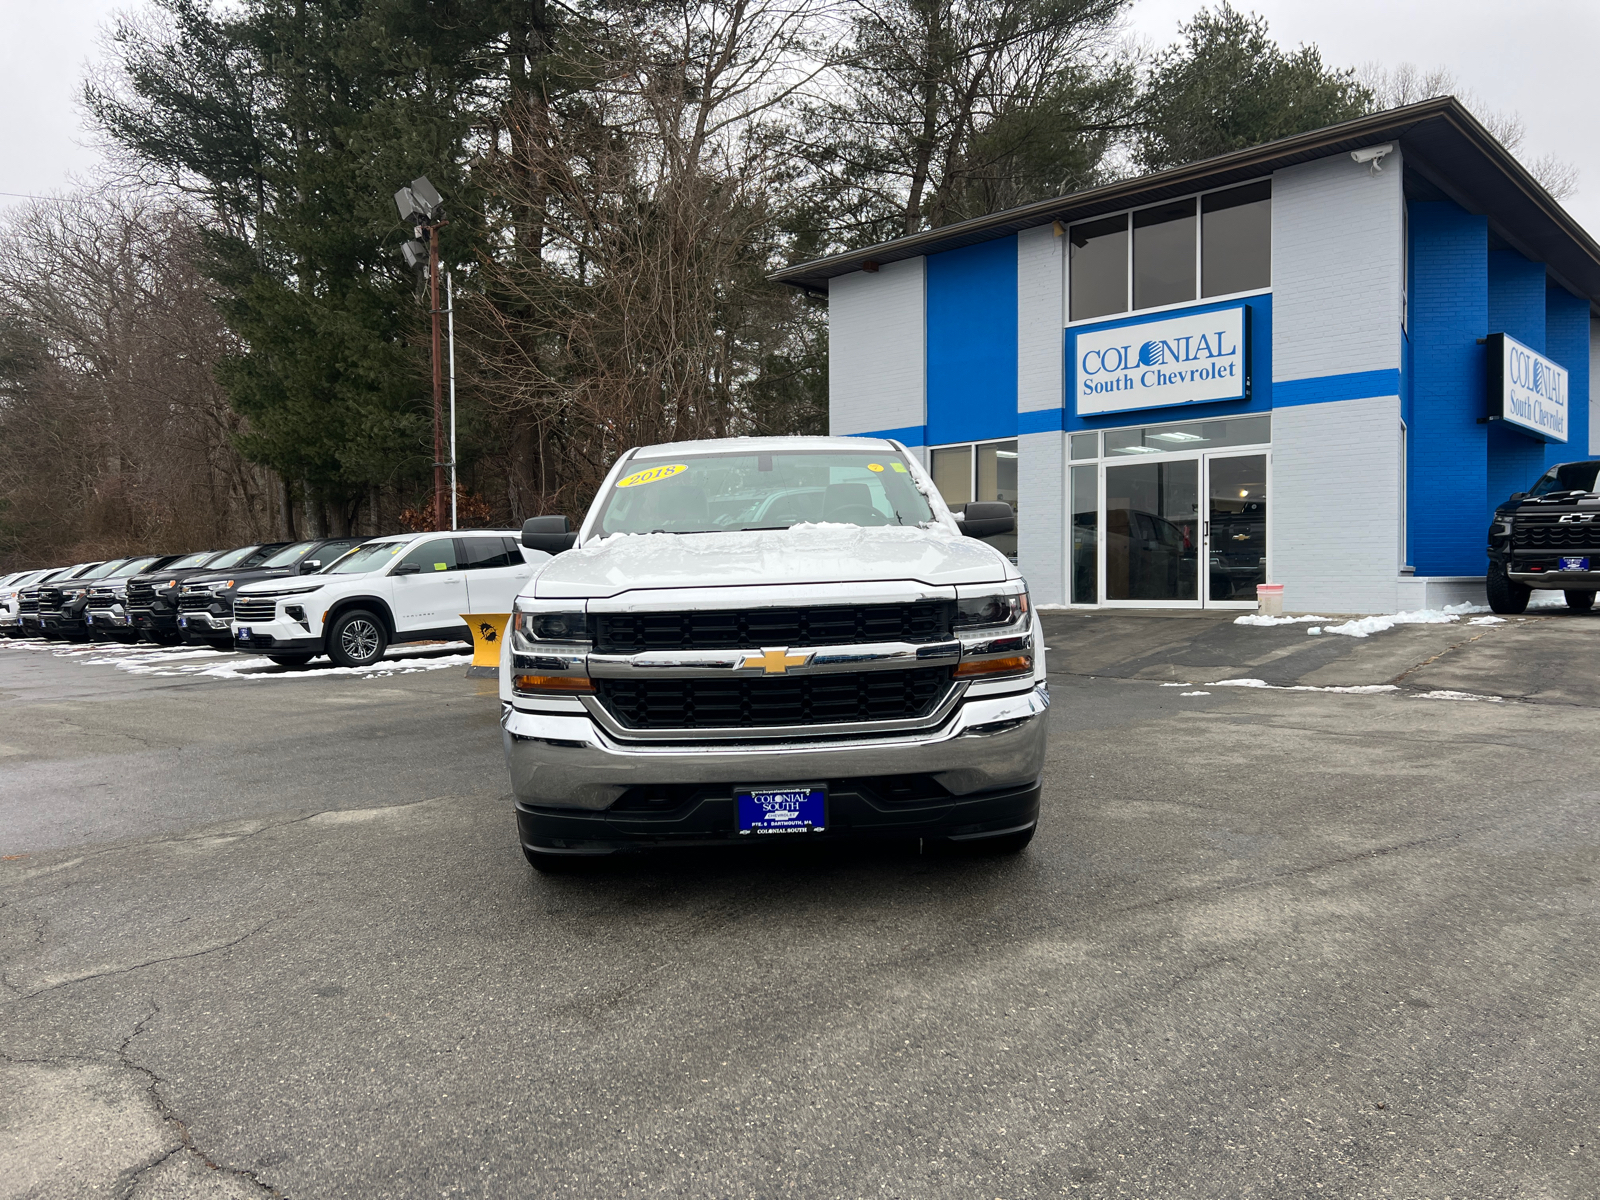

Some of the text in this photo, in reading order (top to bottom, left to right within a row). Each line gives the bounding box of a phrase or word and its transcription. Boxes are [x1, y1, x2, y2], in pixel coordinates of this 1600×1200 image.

[1082, 331, 1237, 376] COLONIAL
[1083, 373, 1134, 396] South
[1140, 361, 1236, 388] Chevrolet
[1510, 346, 1564, 407] COLONIAL
[1510, 388, 1564, 434] South Chevrolet
[628, 465, 676, 486] 2018
[754, 794, 807, 803] COLONIAL
[762, 802, 800, 811] SOUTH
